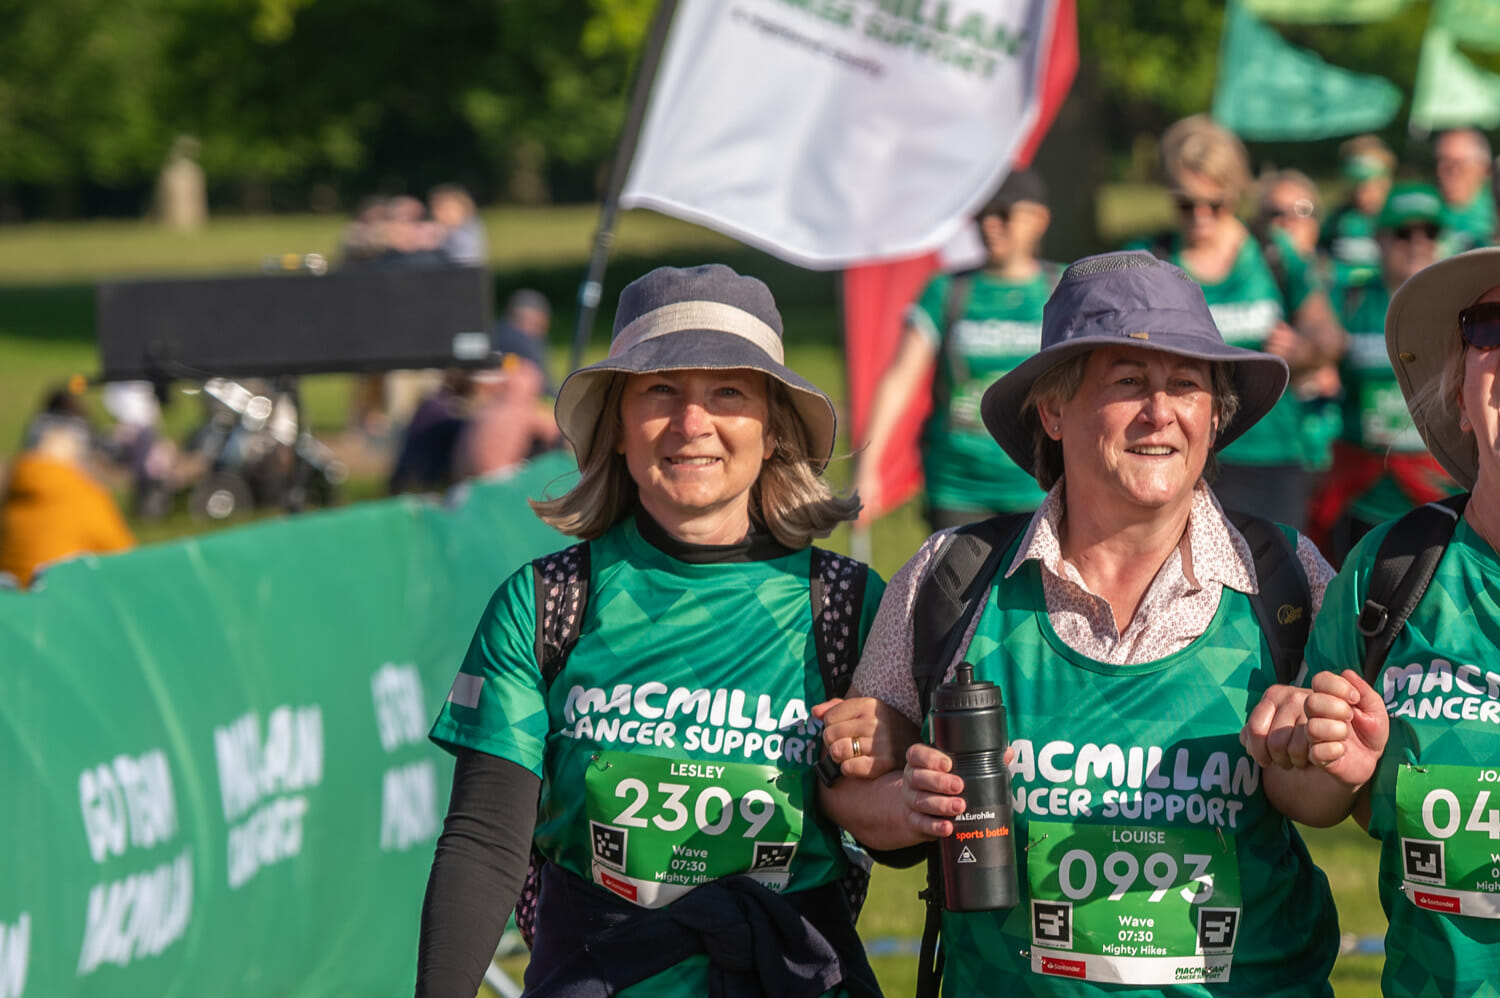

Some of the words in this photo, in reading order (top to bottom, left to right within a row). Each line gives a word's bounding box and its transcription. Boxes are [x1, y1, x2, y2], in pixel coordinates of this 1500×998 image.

[683, 725, 817, 765] SUPPORT
[670, 763, 725, 779] LESLEY
[1007, 738, 1259, 797] ACMILLAN
[612, 778, 775, 838] 2309
[1012, 786, 1092, 817] NCER
[1102, 792, 1243, 828] SUPPORT
[965, 810, 995, 821] Eurohike
[956, 830, 984, 842] sports
[1112, 830, 1165, 844] LOUISE
[672, 844, 708, 859] Wave
[671, 859, 706, 872] 07:30
[655, 871, 690, 885] Mighty
[1058, 849, 1214, 904] 0993
[1118, 915, 1154, 928] Wave
[1118, 930, 1153, 942] 07:30
[1102, 944, 1137, 956] Mighty
[1140, 945, 1167, 955] Hikes
[1175, 966, 1225, 975] MACMIAN
